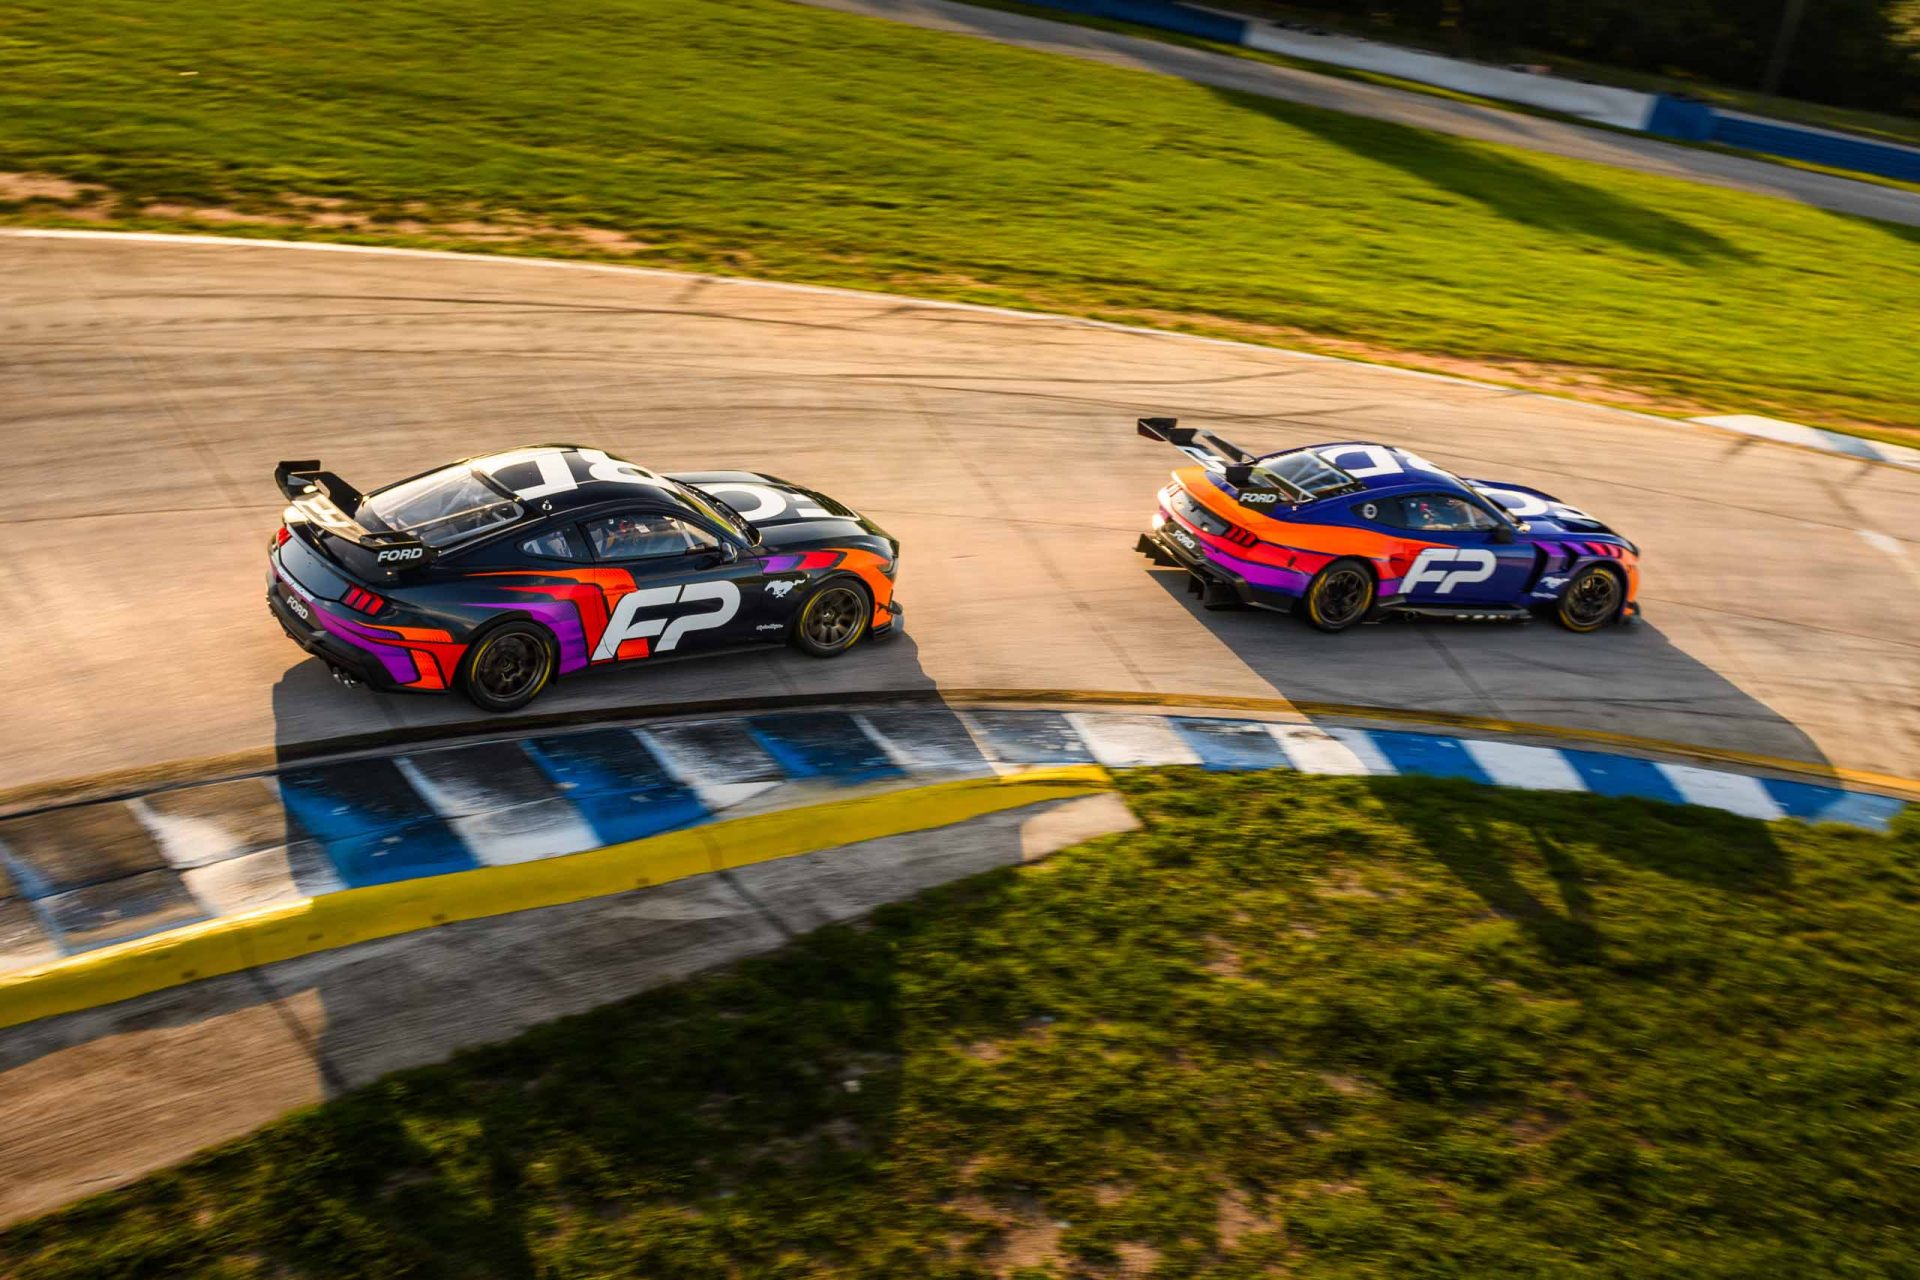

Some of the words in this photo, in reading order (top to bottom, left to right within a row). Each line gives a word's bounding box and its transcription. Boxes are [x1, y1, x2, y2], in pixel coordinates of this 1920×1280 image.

[1239, 492, 1277, 503] FORD
[377, 547, 423, 563] FORD
[1398, 548, 1497, 594] FP
[286, 596, 308, 620] FORD
[591, 580, 741, 661] FP
